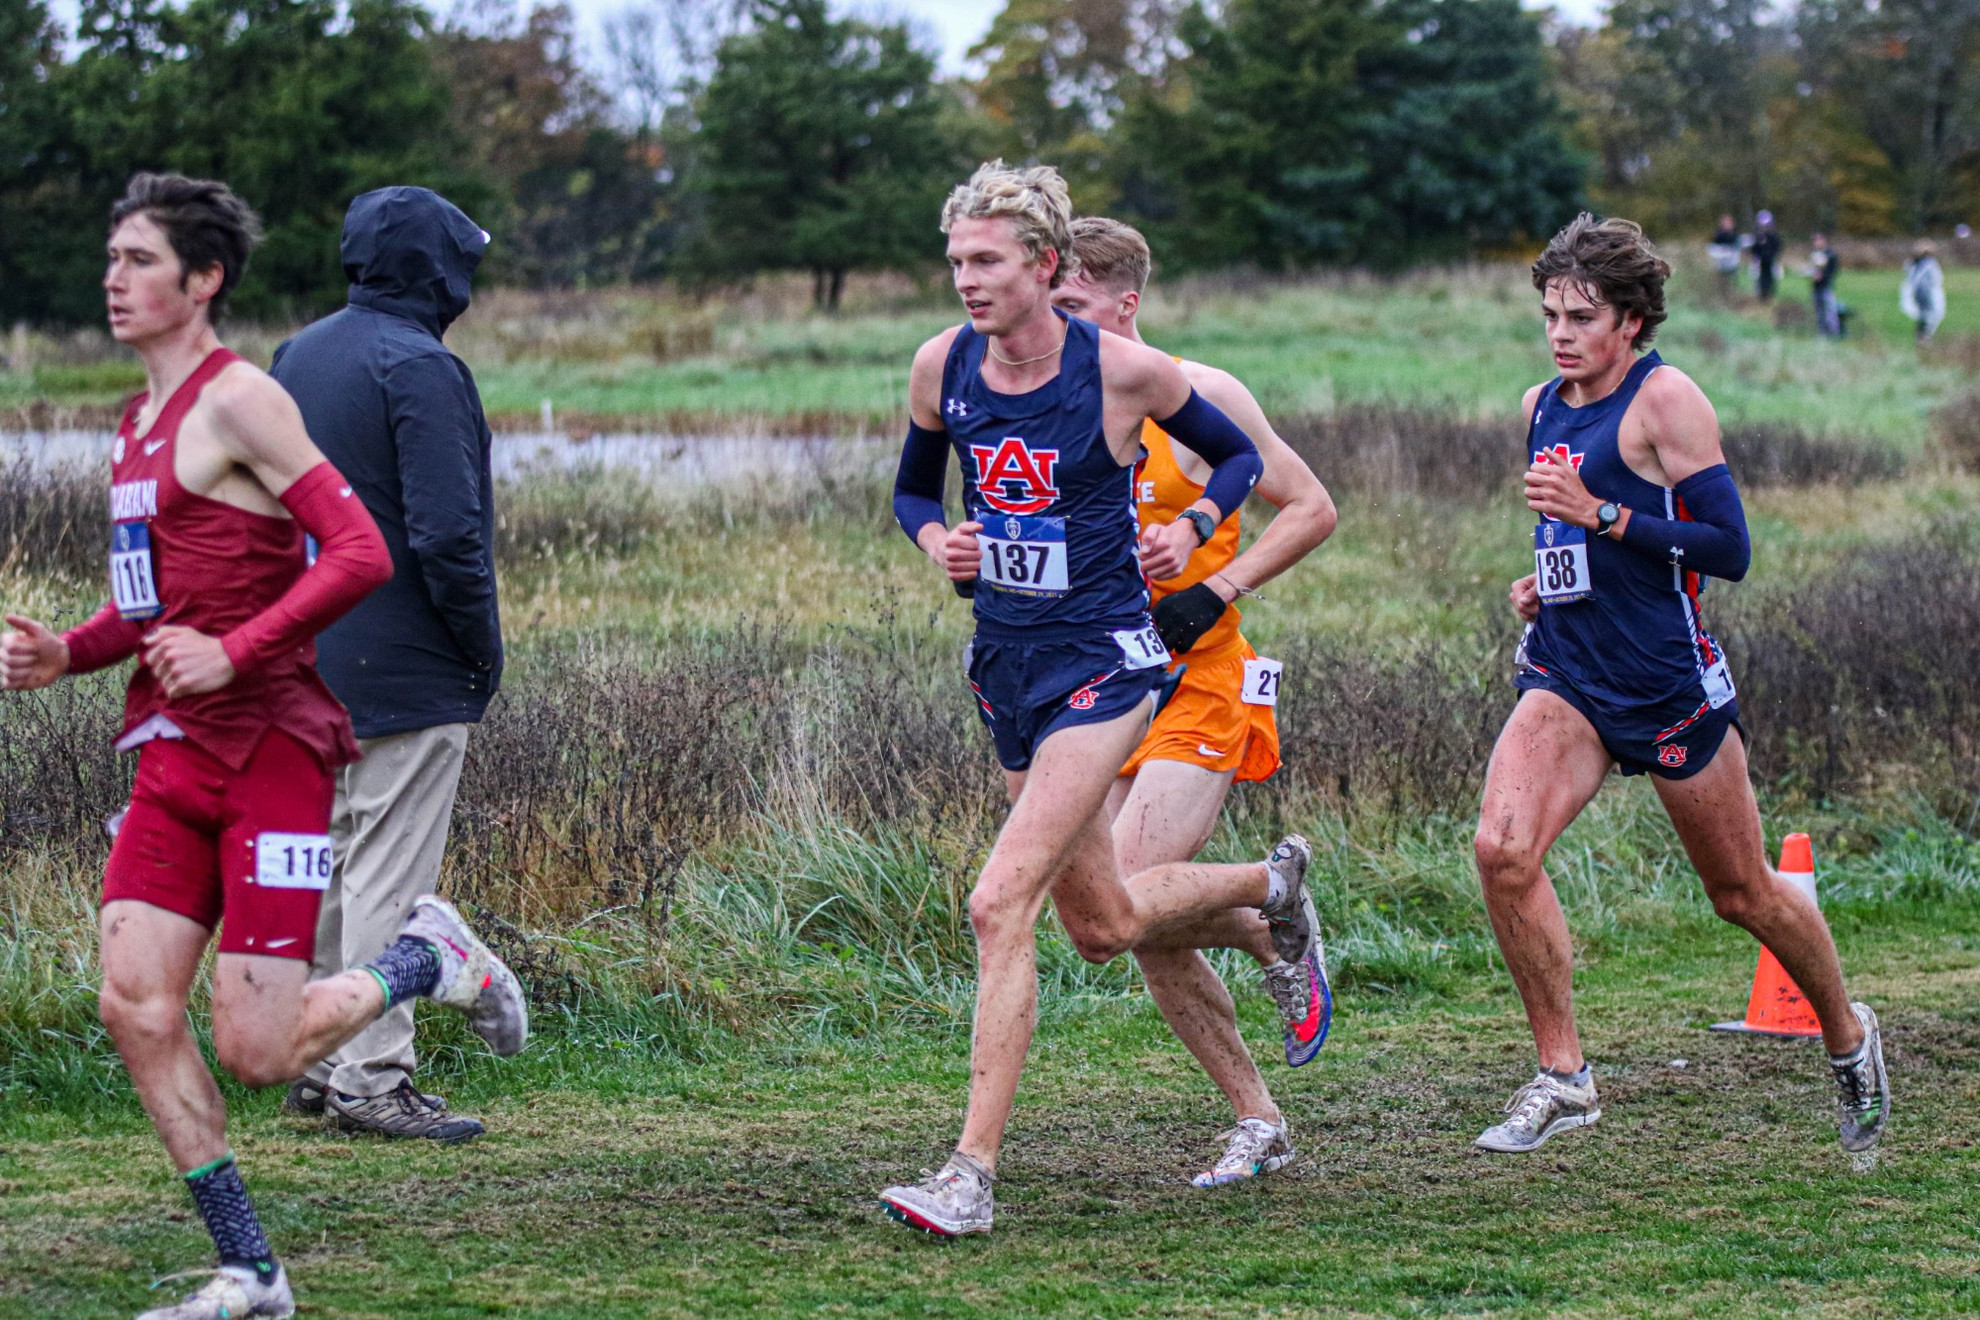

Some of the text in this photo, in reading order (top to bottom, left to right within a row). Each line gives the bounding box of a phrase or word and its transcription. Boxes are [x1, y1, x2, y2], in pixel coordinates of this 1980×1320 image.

[988, 542, 1050, 585] 137
[1537, 549, 1577, 591] 138
[116, 556, 149, 604] 116
[1134, 629, 1164, 658] 13
[1258, 669, 1280, 697] 21
[1718, 668, 1732, 691] 1
[283, 846, 331, 878] 116
